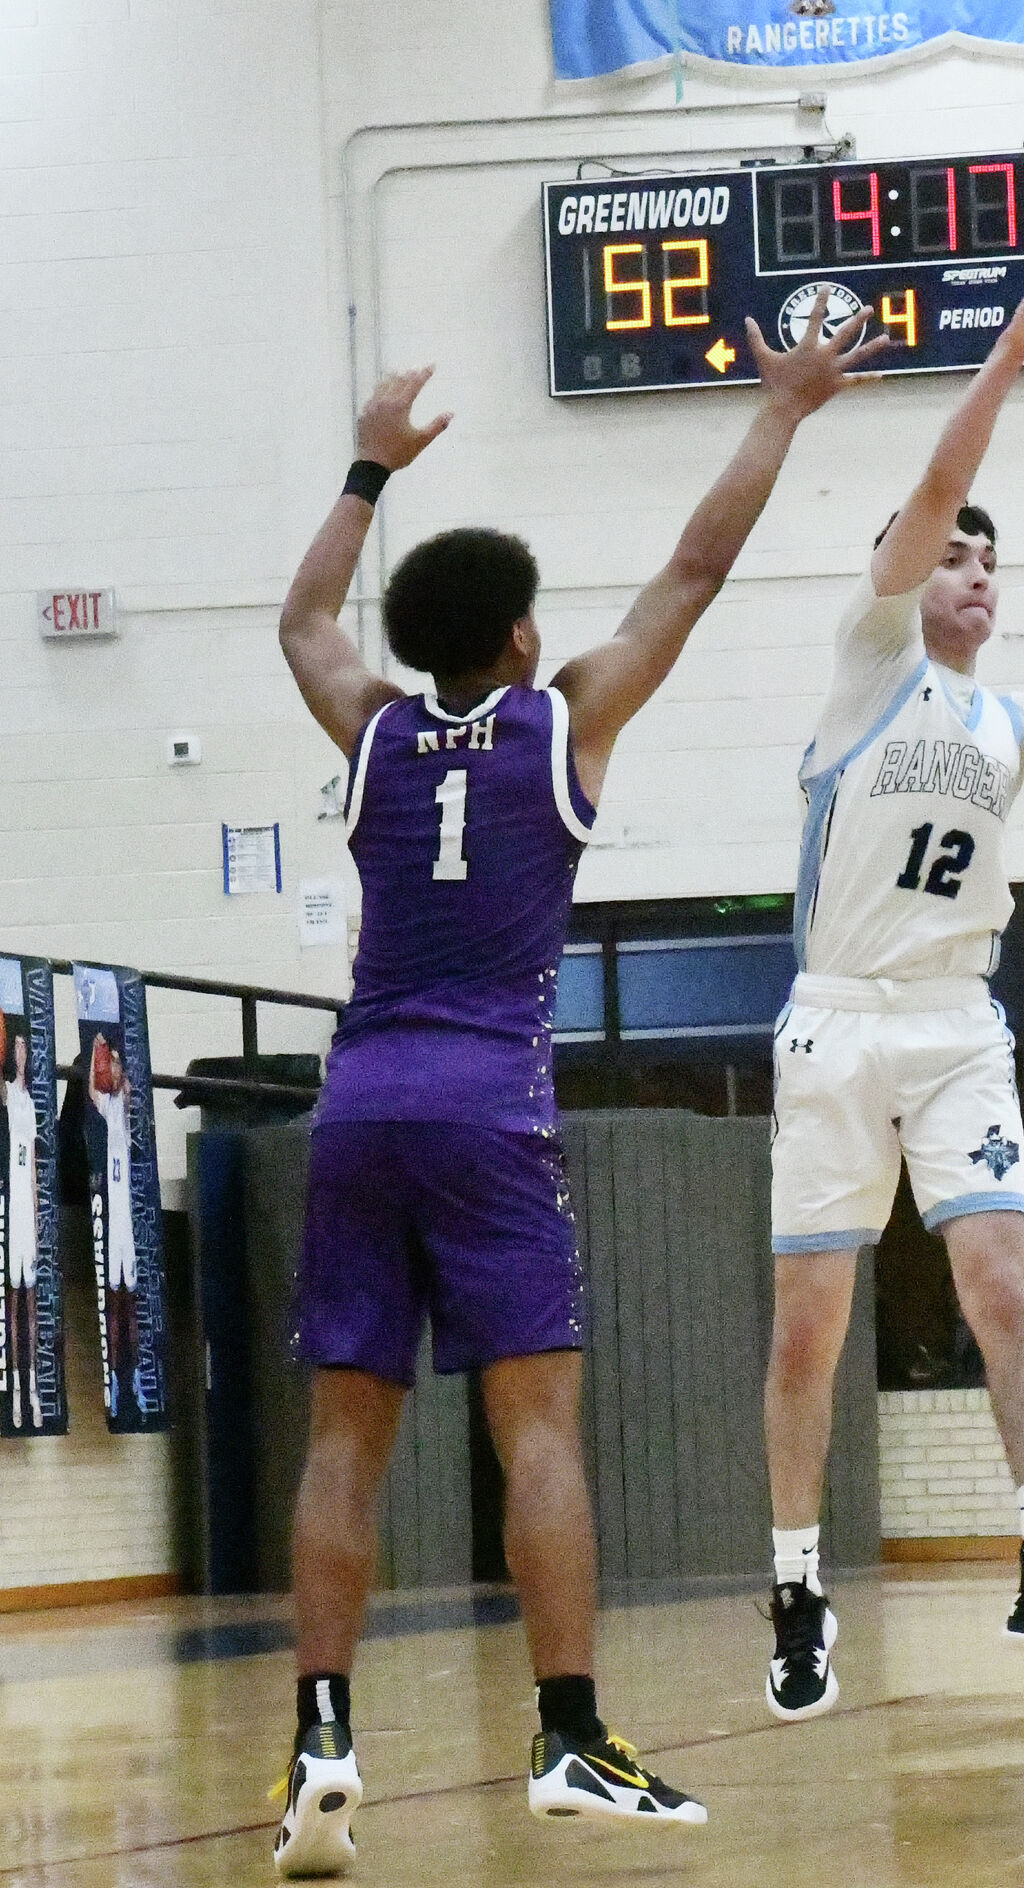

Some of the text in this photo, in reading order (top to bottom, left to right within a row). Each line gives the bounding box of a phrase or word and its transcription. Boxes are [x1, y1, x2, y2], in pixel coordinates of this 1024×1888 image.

[727, 12, 909, 55] RANGERETTES
[558, 186, 731, 236] GREENWOOD
[832, 163, 1017, 257] 4:17
[603, 239, 711, 331] 52
[881, 289, 917, 347] 4
[939, 306, 1005, 331] PERIOD
[53, 592, 102, 632] EXIT
[432, 769, 468, 881] 1
[896, 822, 976, 900] 12
